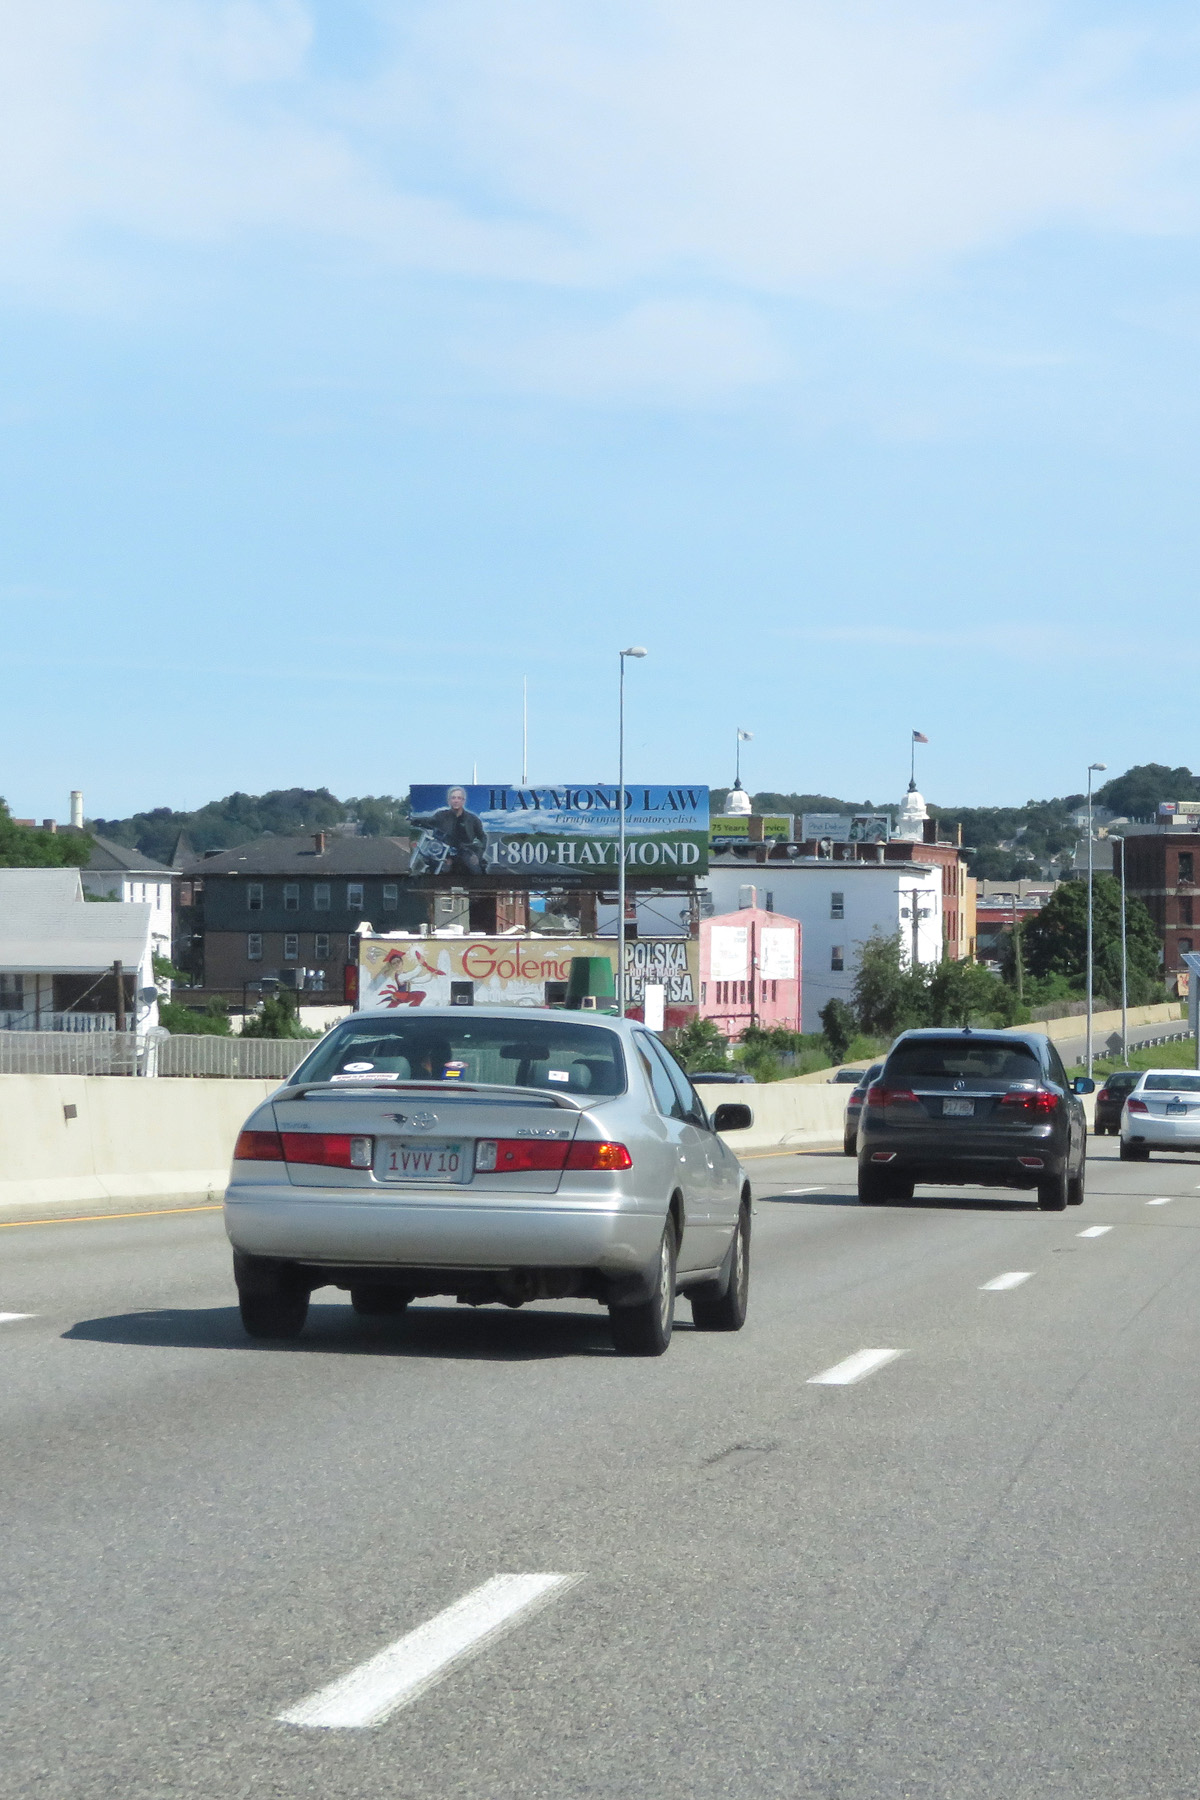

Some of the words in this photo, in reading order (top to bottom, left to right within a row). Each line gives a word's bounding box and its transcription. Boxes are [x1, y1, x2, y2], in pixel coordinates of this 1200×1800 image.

[489, 789, 633, 811] HAYMOND
[642, 789, 703, 811] LAW
[633, 814, 698, 826] motorcyclists
[712, 823, 722, 832] 75
[724, 823, 746, 832] Years
[624, 942, 689, 971] POLSKA
[630, 967, 656, 977] HOME
[656, 967, 681, 977] MADE
[389, 1152, 433, 1171] 1VVV
[437, 1152, 459, 1172] 10
